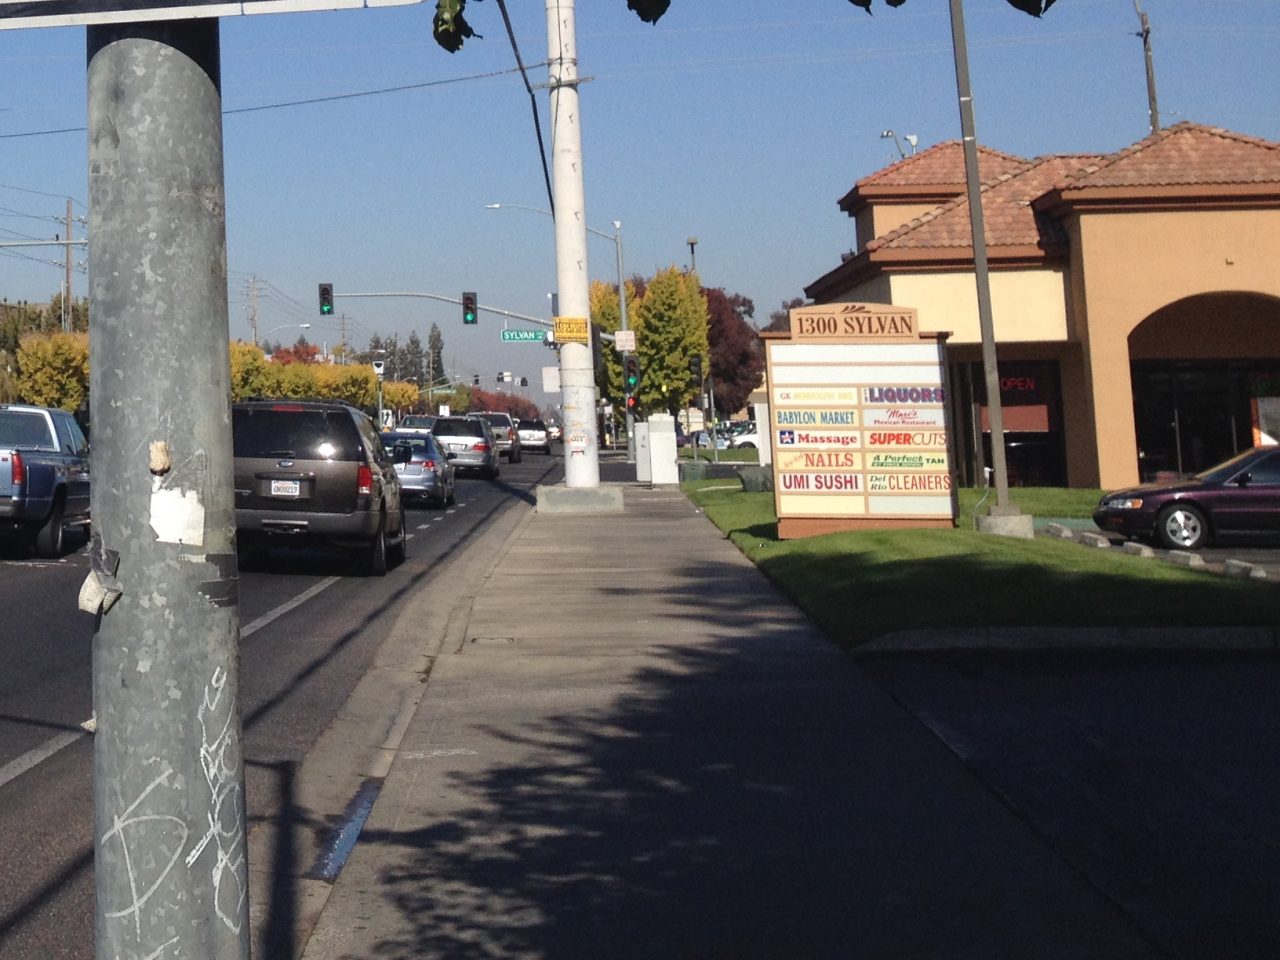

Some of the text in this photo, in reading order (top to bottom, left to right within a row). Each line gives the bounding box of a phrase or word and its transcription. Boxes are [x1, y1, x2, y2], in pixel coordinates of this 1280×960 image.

[797, 315, 913, 335] 1300 SYLVAN
[503, 330, 535, 340] SYLVAN
[1001, 377, 1035, 390] OPEN
[868, 387, 945, 403] LIQUORS
[777, 411, 854, 424] BABYLON MARKET
[798, 433, 858, 445] Massage
[869, 432, 947, 445] SUPERCUTS
[804, 453, 854, 467] NAILS
[884, 454, 924, 462] Perfect
[783, 474, 858, 490] UMI SUSHI
[888, 475, 951, 490] CLEANERS
